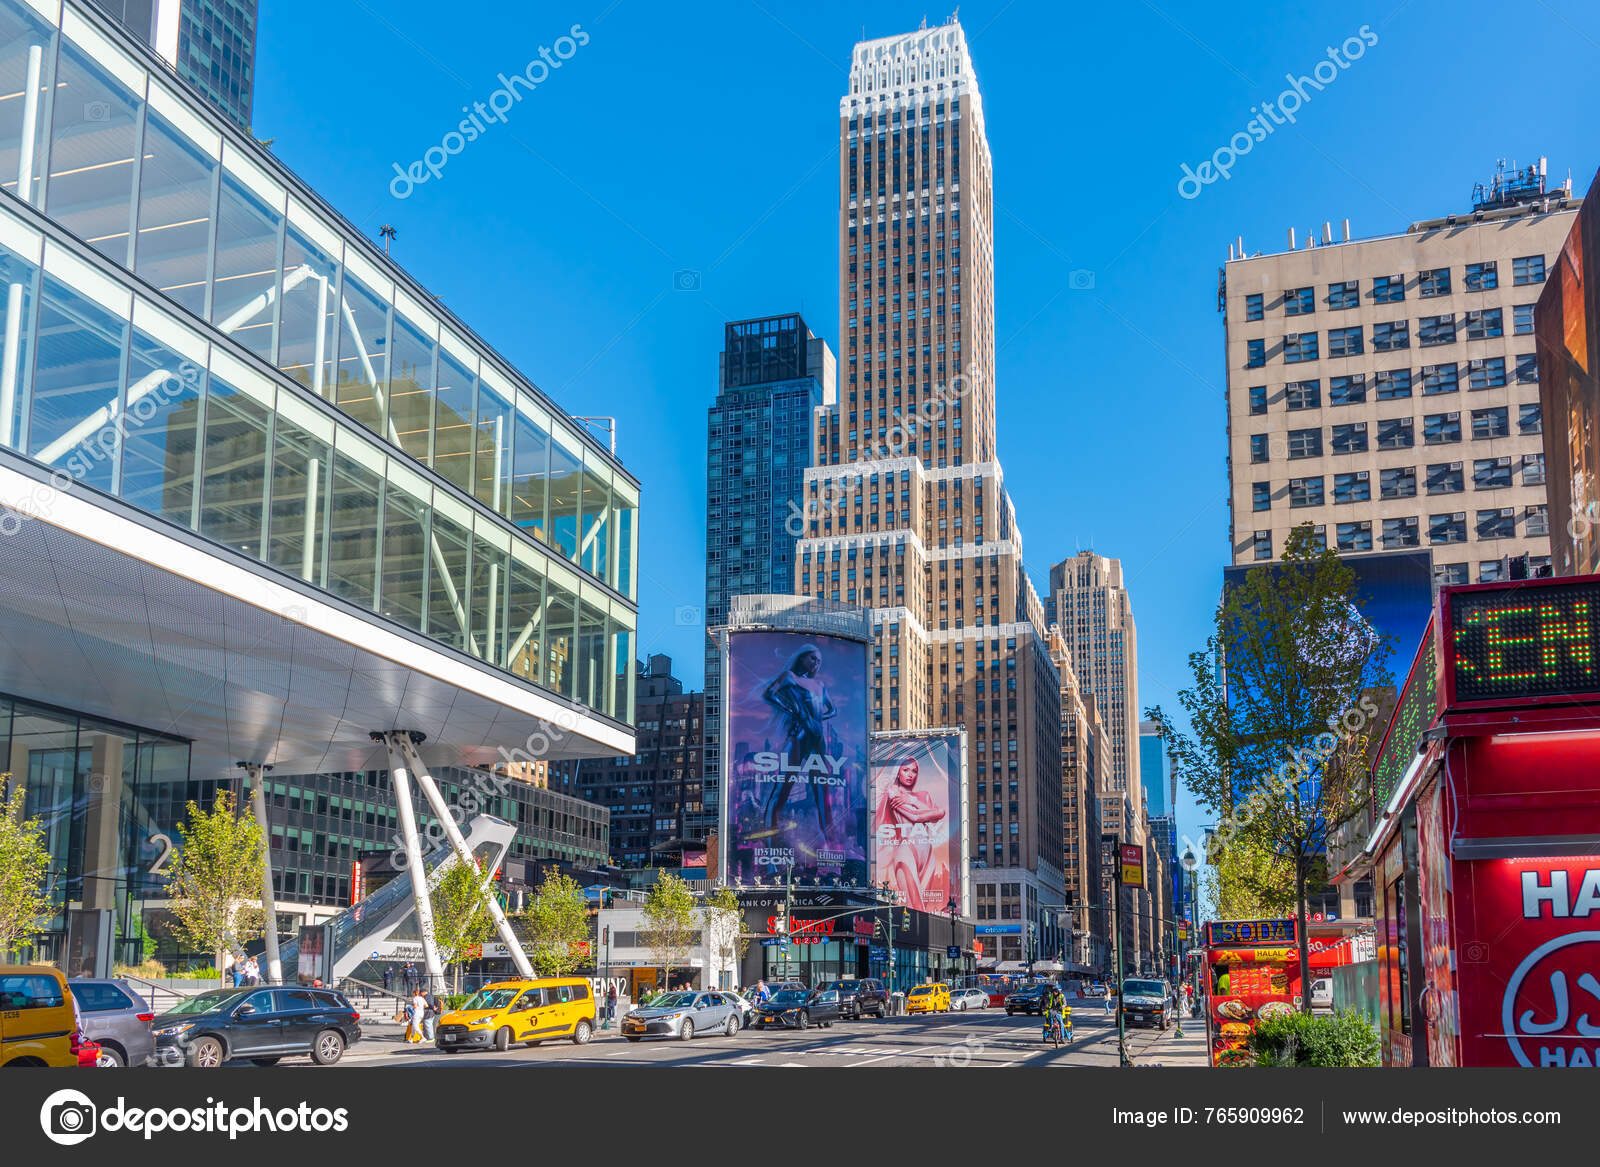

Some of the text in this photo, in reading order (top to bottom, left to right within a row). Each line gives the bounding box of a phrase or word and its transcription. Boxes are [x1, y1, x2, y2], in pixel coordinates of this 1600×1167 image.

[753, 751, 848, 775] SLAY
[755, 774, 847, 787] LIKE AN ICON
[878, 823, 945, 838] STAY
[149, 834, 172, 875] 2
[754, 856, 795, 865] ICON
[819, 851, 844, 860] Hilton
[760, 899, 772, 907] OF
[767, 915, 835, 936] Sbway
